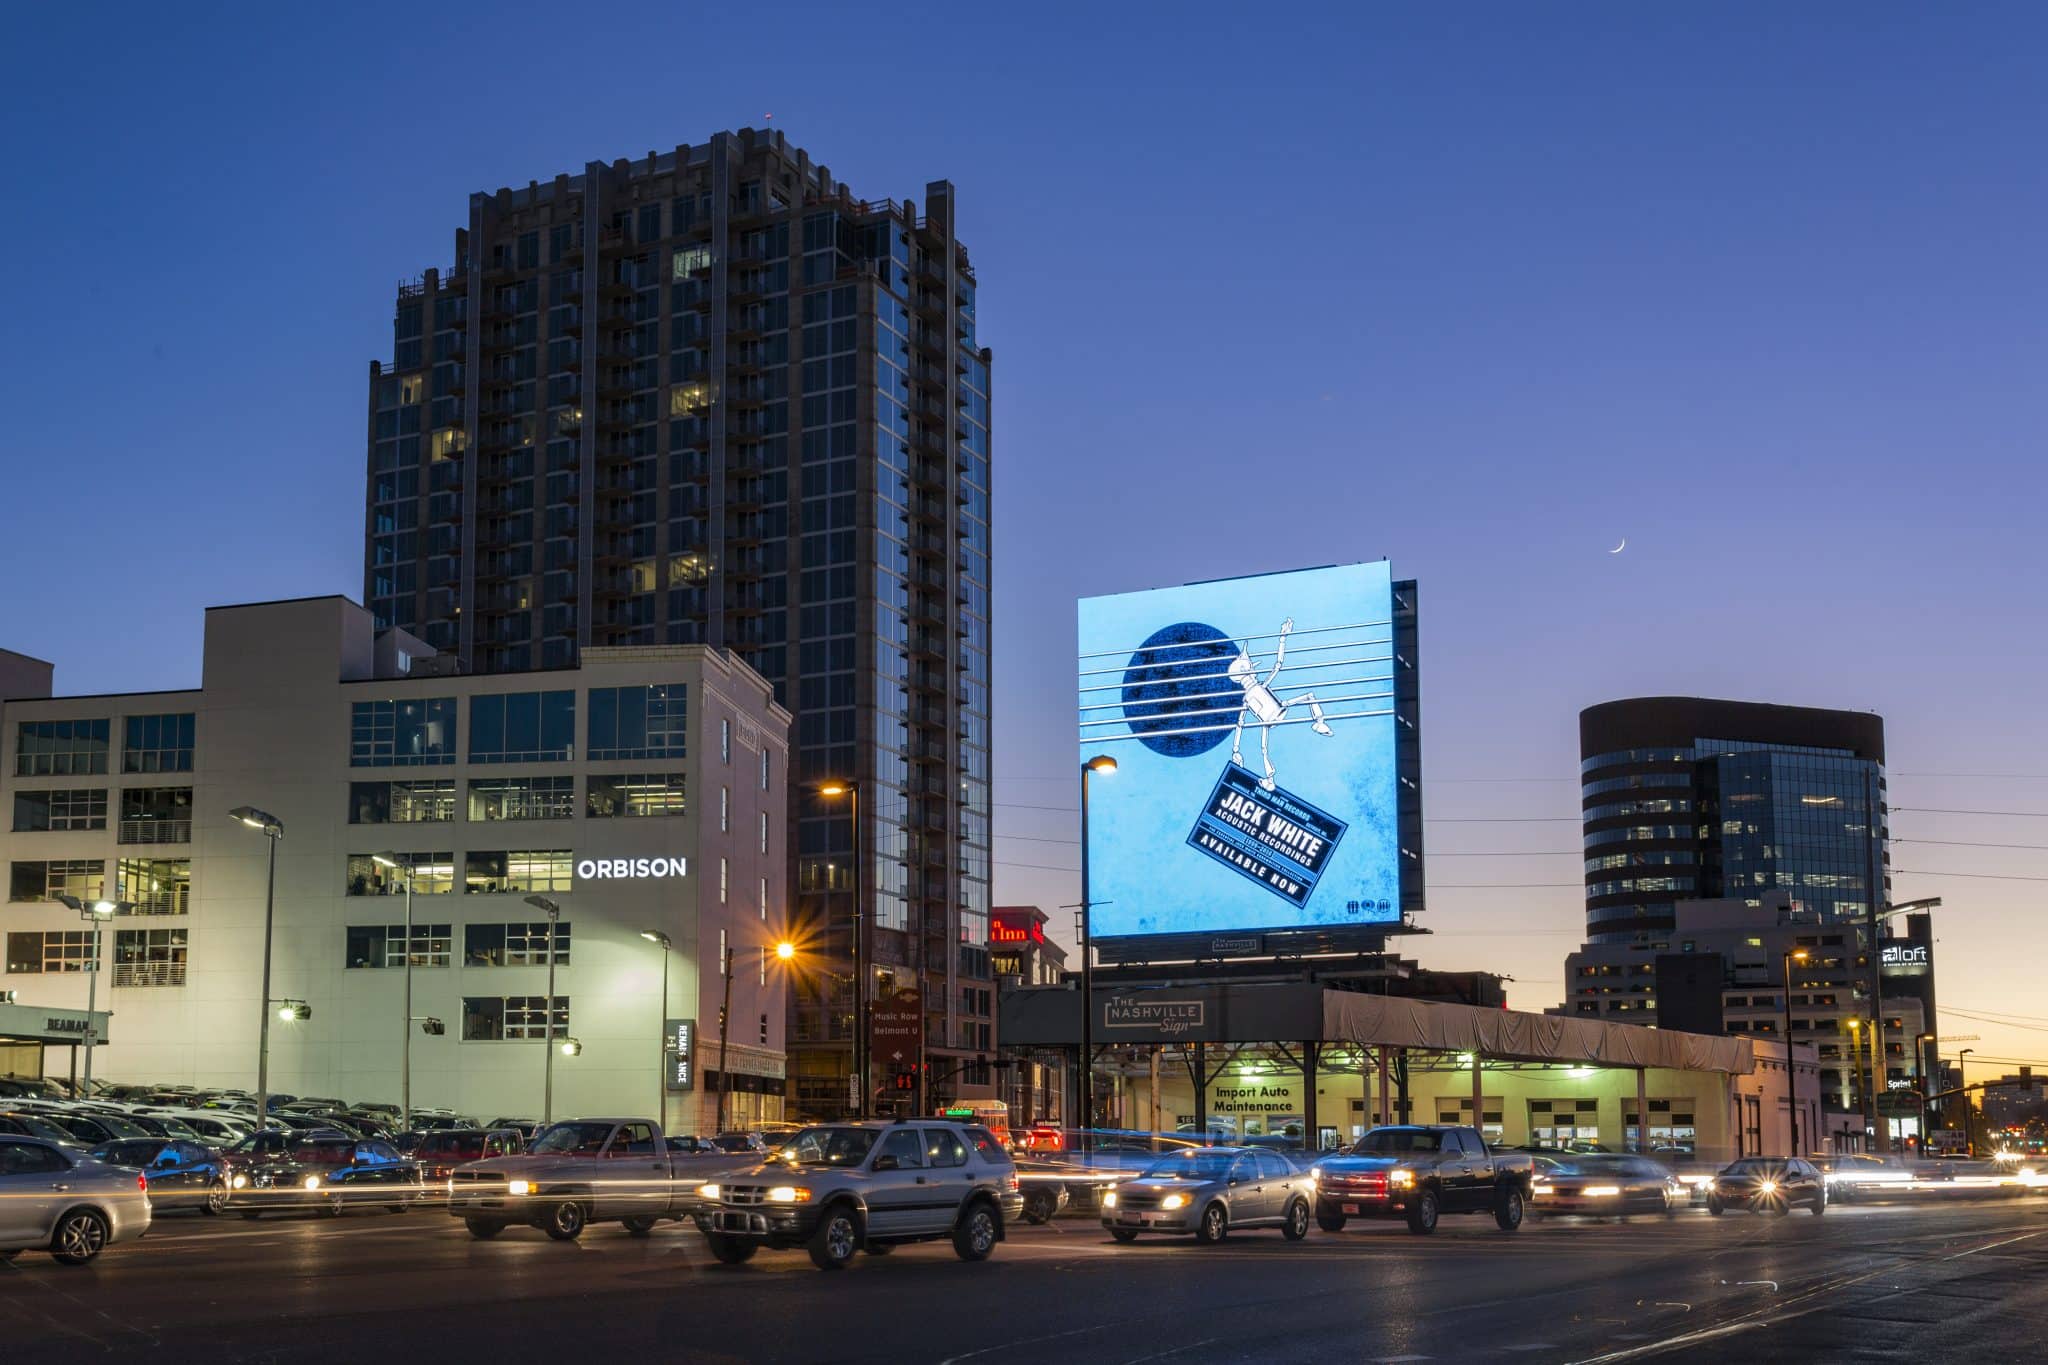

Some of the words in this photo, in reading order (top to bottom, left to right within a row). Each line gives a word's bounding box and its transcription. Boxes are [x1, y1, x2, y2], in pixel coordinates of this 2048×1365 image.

[1271, 795, 1285, 808] MAN
[1284, 803, 1311, 821] RECORDS
[1220, 790, 1268, 827] JACK
[1266, 814, 1322, 857] WHITE
[1215, 808, 1257, 835] ACOUSTIC
[1258, 831, 1312, 867] RECORDINGS
[577, 857, 686, 880] ORBISON
[1200, 833, 1266, 877] AVAILABLE
[1269, 873, 1299, 895] NOW
[1000, 927, 1027, 941] Inn
[1882, 945, 1927, 962] aloft
[1112, 996, 1134, 1007] THE
[874, 1012, 897, 1021] Music
[900, 1012, 919, 1021] Row
[1111, 1006, 1197, 1019] NASHVILLE
[874, 1027, 909, 1036] Belmont
[911, 1027, 919, 1035] U
[1160, 1018, 1189, 1035] Sign
[1216, 1086, 1257, 1100] Import
[1260, 1086, 1289, 1097] Auto
[1214, 1100, 1293, 1112] Maintenance
